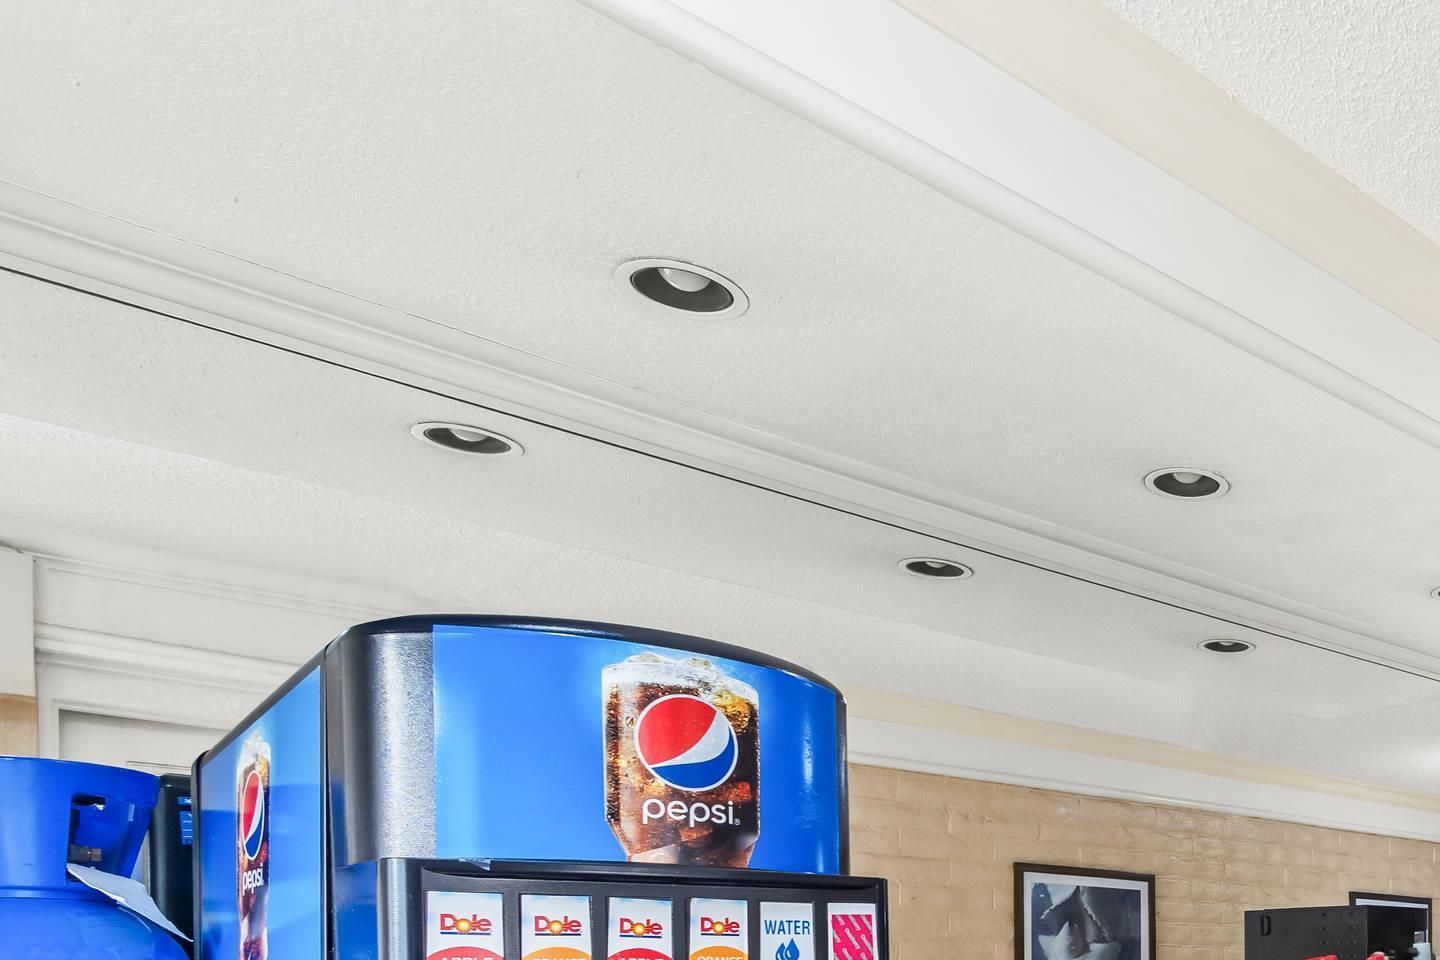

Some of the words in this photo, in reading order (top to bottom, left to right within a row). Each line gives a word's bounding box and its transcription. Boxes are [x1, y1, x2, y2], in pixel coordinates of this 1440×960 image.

[642, 798, 734, 828] pepsi
[242, 863, 264, 896] pepsi
[439, 913, 493, 933] Dole
[534, 915, 583, 935] Dole
[619, 917, 663, 936] Dole
[700, 916, 741, 934] Dole
[764, 919, 810, 935] WATER
